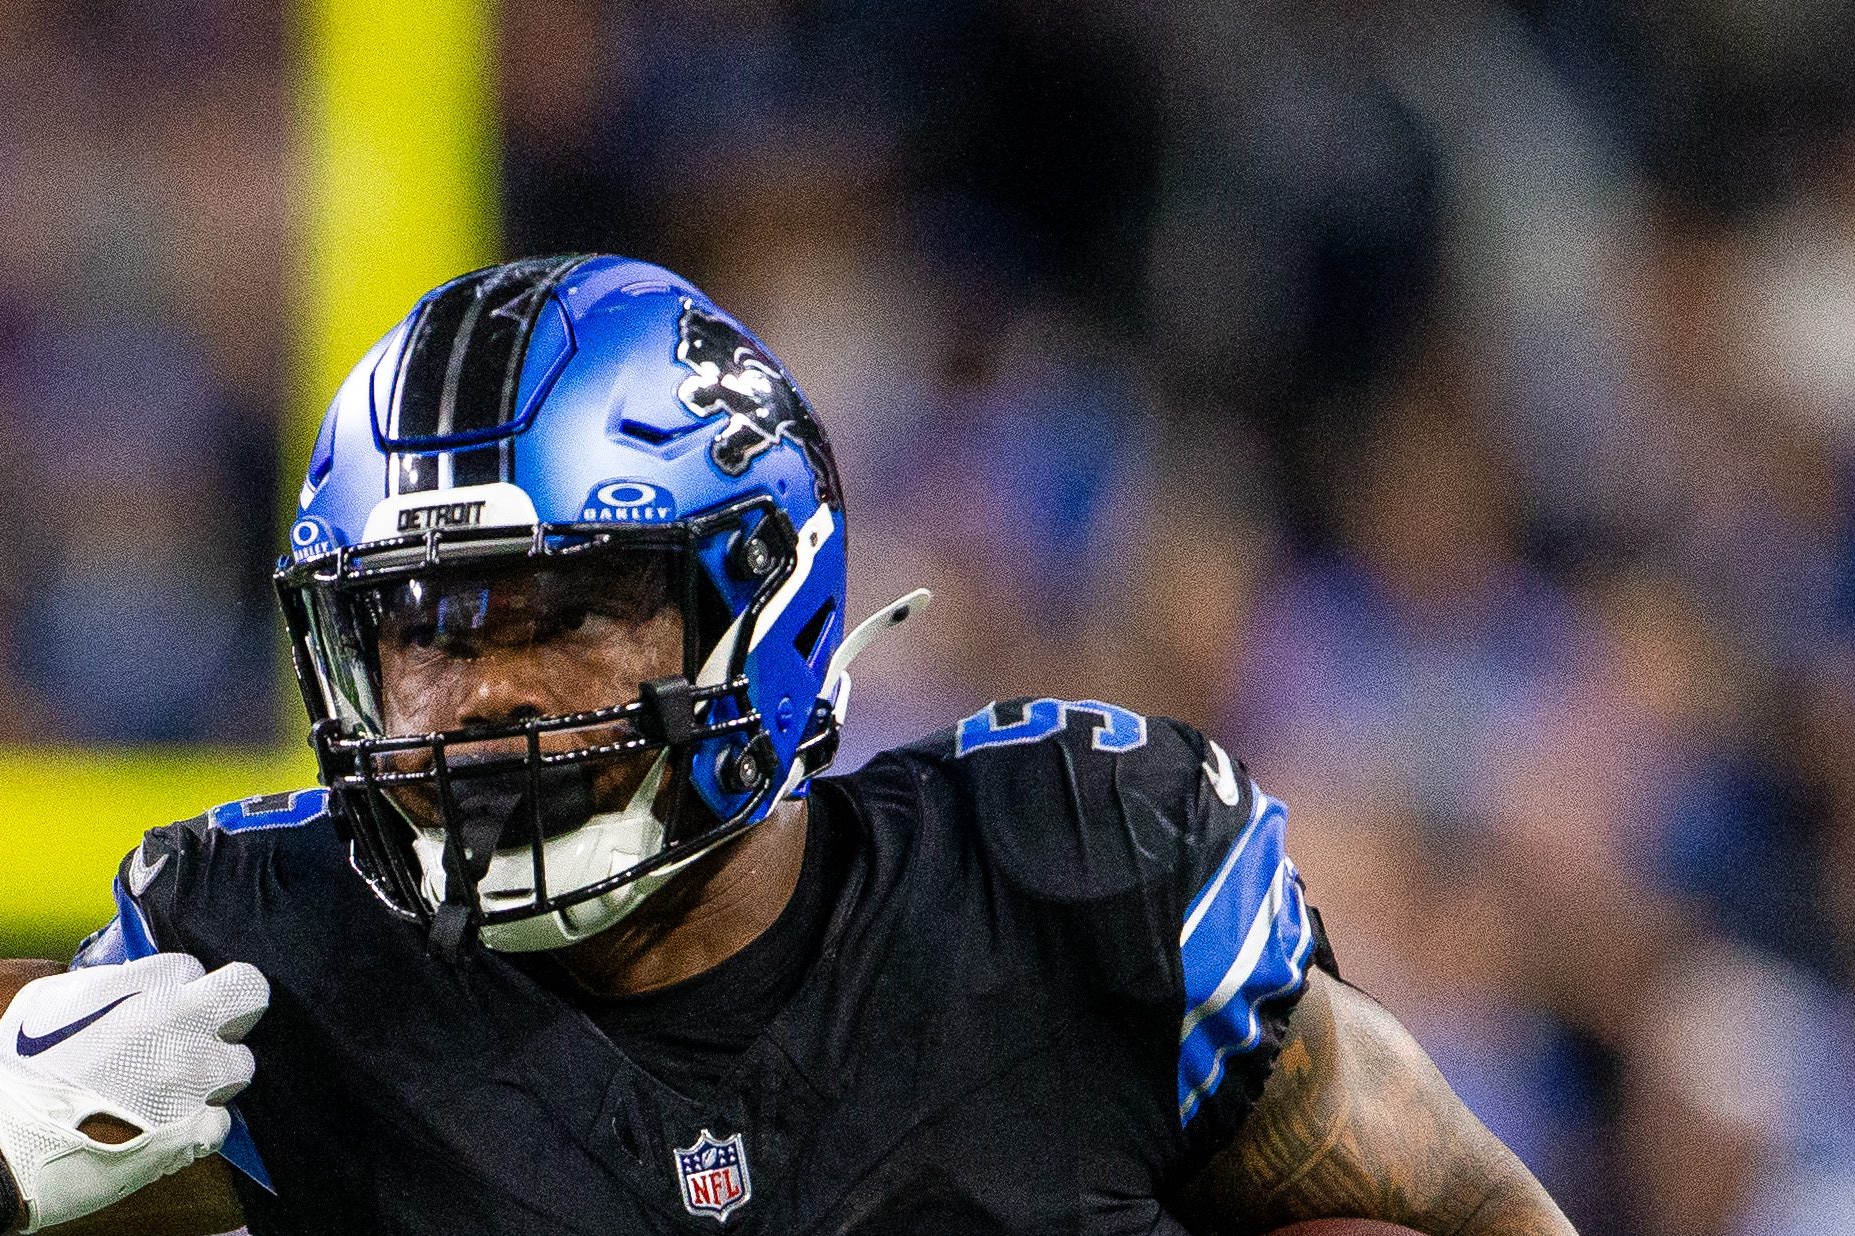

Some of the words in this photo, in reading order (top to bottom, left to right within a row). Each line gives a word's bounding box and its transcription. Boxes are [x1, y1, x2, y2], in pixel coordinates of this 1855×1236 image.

[397, 500, 486, 531] DETROIT
[583, 507, 668, 521] OAKLEY
[691, 1168, 740, 1206] NFL
